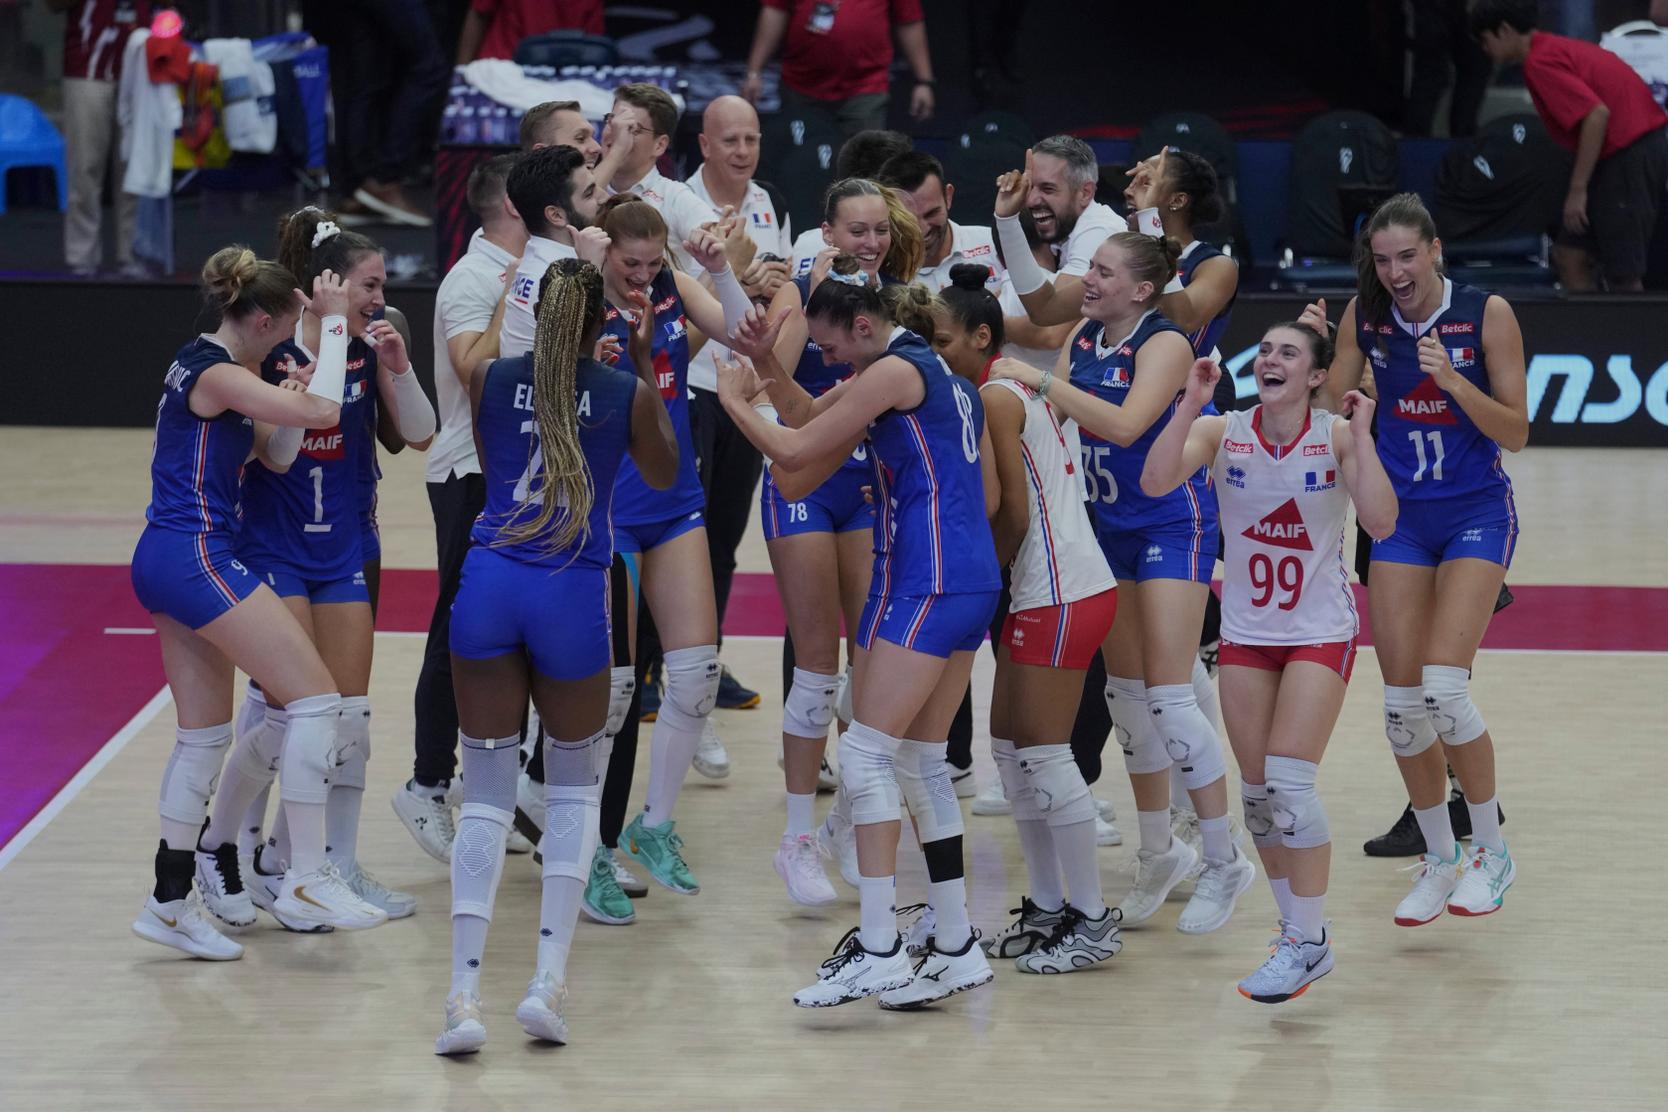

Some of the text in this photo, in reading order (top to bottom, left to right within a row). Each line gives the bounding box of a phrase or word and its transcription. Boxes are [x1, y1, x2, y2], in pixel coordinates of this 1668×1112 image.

[1441, 324, 1473, 334] Betclic
[1398, 399, 1447, 415] MAIF
[300, 434, 344, 452] MAIF
[1225, 440, 1253, 454] Betclic
[1408, 430, 1446, 482] 11
[1305, 481, 1337, 493] FRANCE
[304, 465, 333, 534] 1
[788, 502, 809, 523] 78
[1254, 521, 1305, 539] MAIF
[1248, 553, 1304, 611] 99
